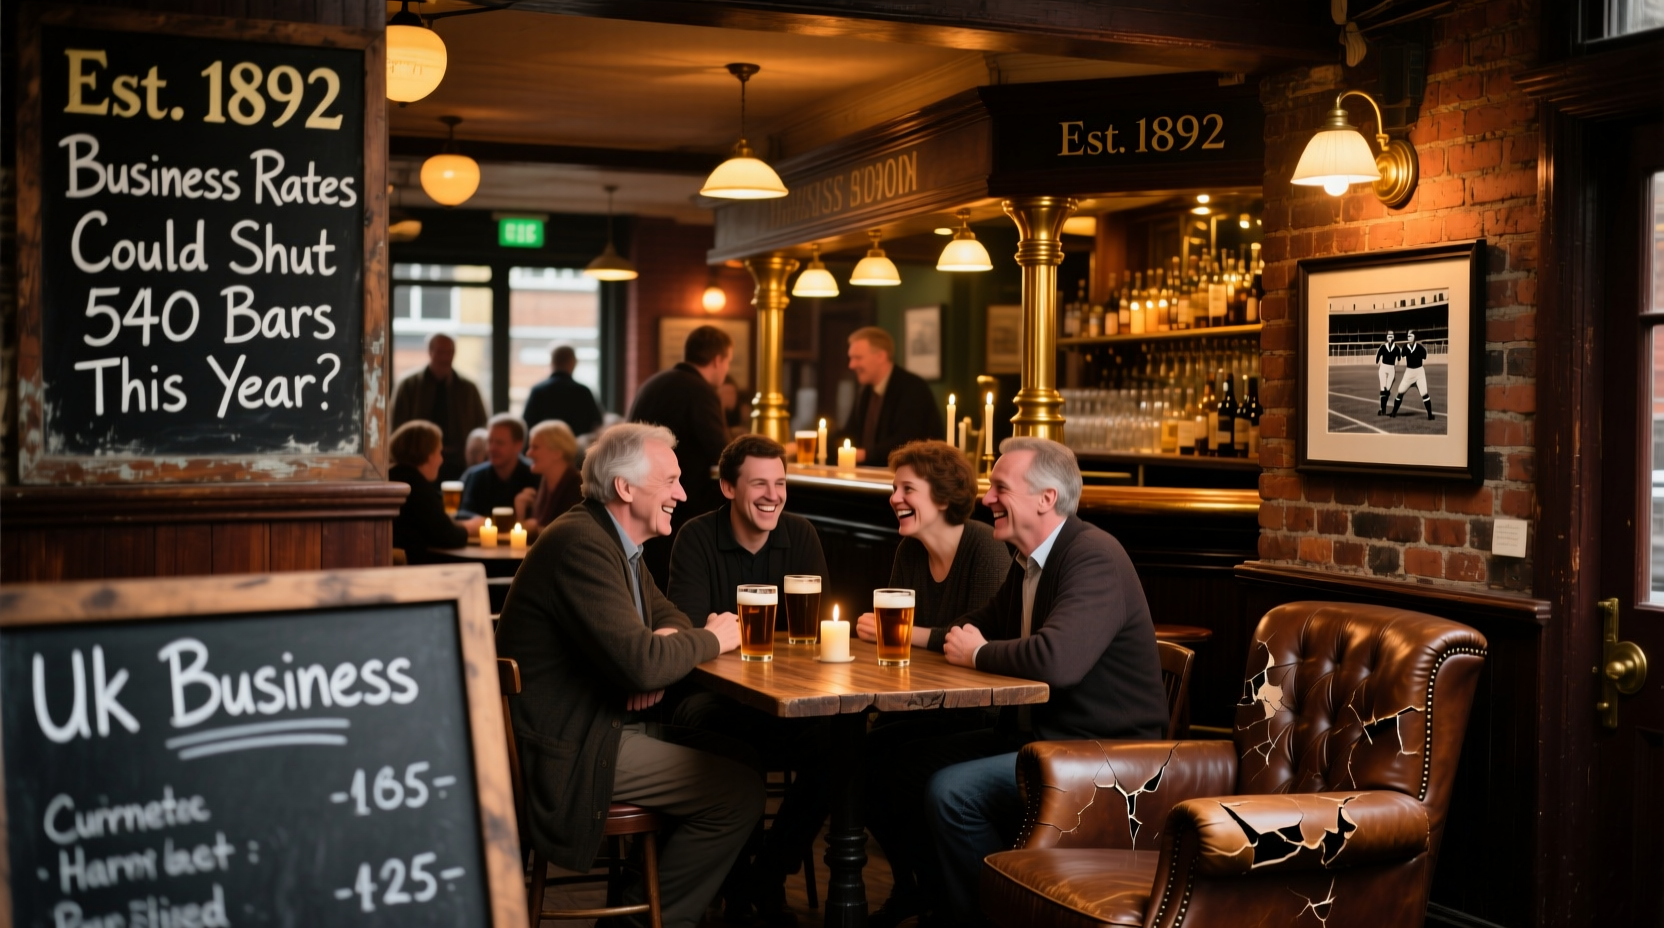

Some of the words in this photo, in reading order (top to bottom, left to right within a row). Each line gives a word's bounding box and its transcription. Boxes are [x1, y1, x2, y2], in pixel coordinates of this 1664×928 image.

[64, 49, 185, 120] Est.
[201, 61, 343, 130] 1892
[1057, 120, 1126, 156] Est.
[1135, 113, 1225, 152] 1892
[59, 134, 241, 201] Business
[250, 149, 357, 208] Rates
[71, 210, 208, 273] Could
[229, 220, 337, 276] Shut
[84, 287, 200, 346] 540
[220, 285, 336, 344] Bars
[74, 356, 187, 415] This
[206, 353, 341, 418] Year?
[33, 645, 140, 743] Uk
[158, 638, 419, 728] Business
